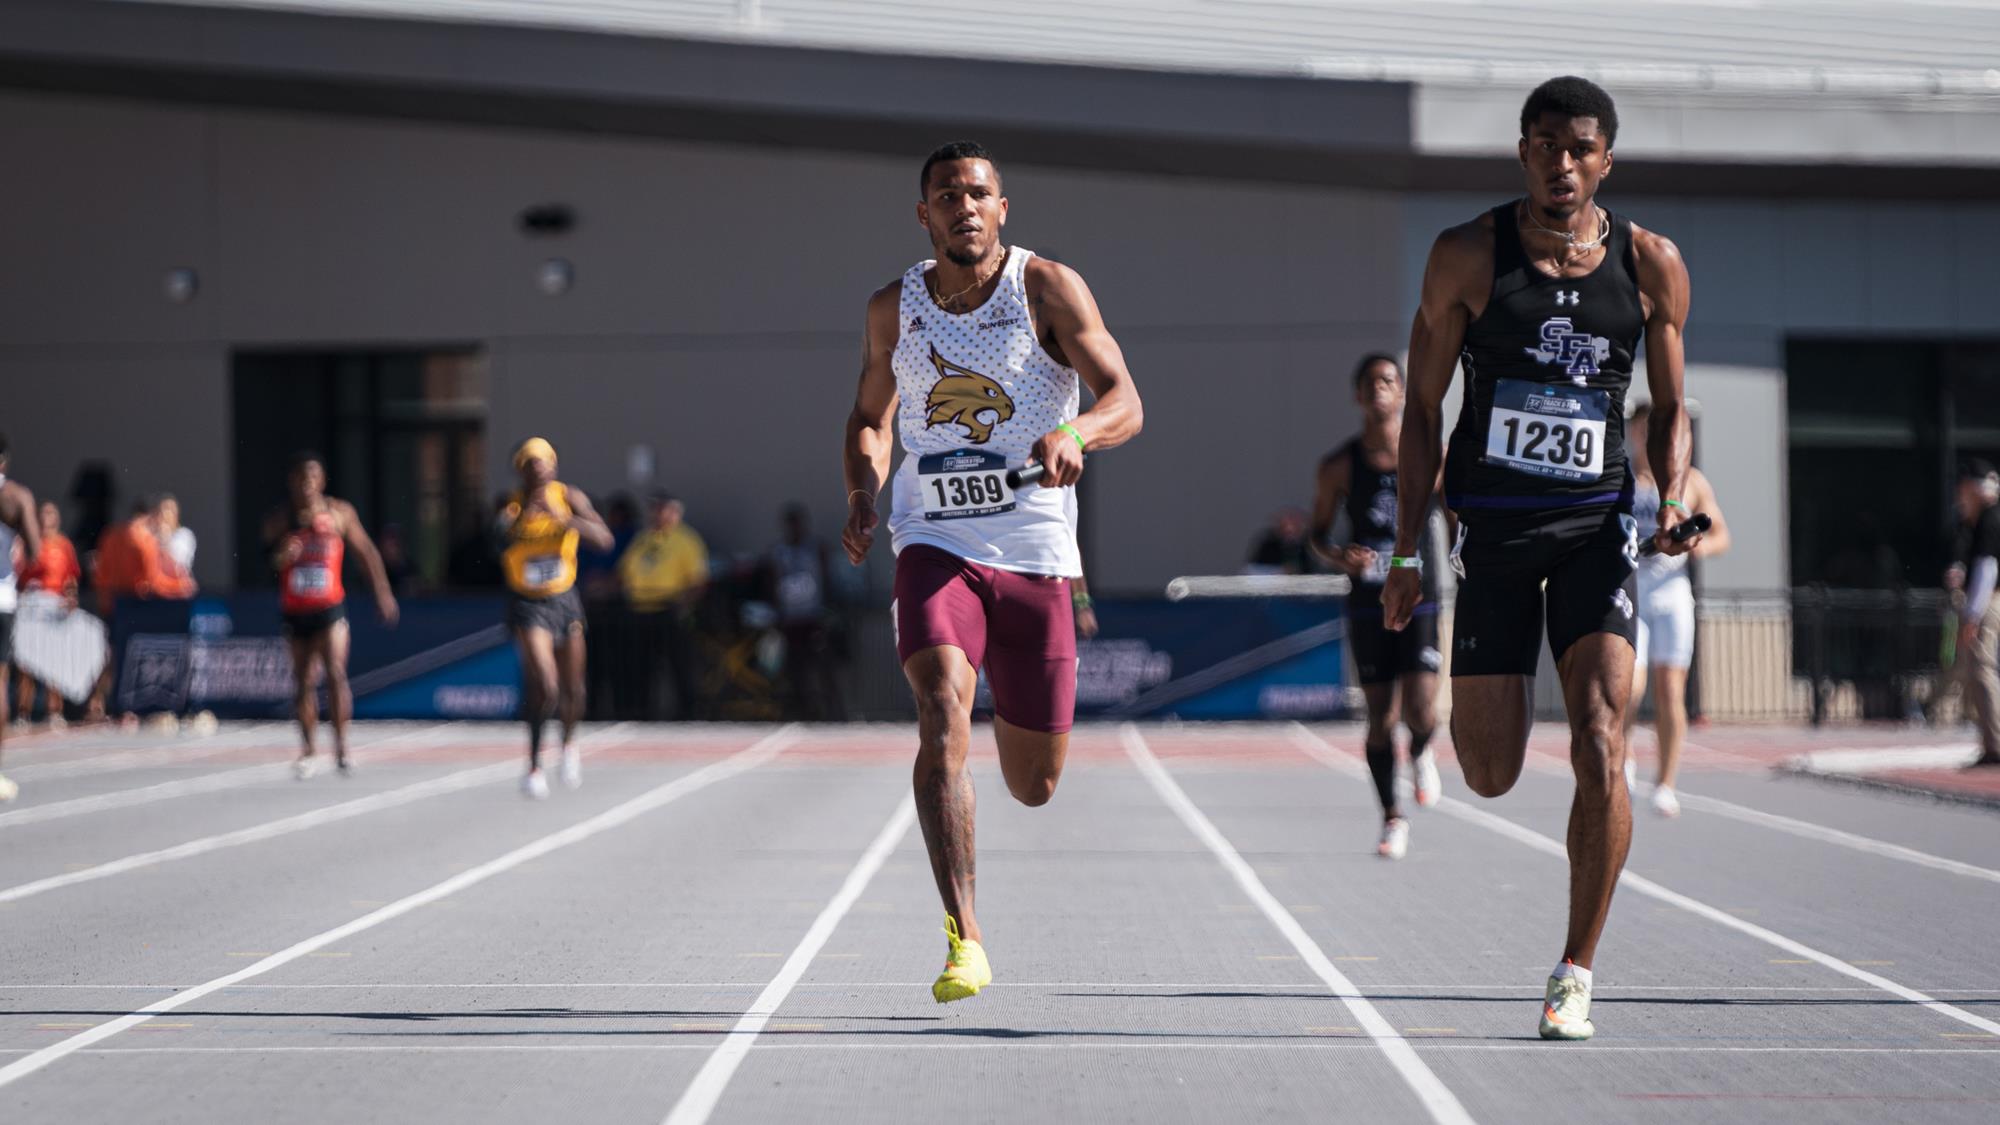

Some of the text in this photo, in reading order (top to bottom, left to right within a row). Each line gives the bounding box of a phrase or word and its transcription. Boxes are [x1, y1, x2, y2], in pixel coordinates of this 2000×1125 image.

[1541, 317, 1600, 375] SFA
[1504, 417, 1594, 468] 1239
[931, 474, 1004, 507] 1369
